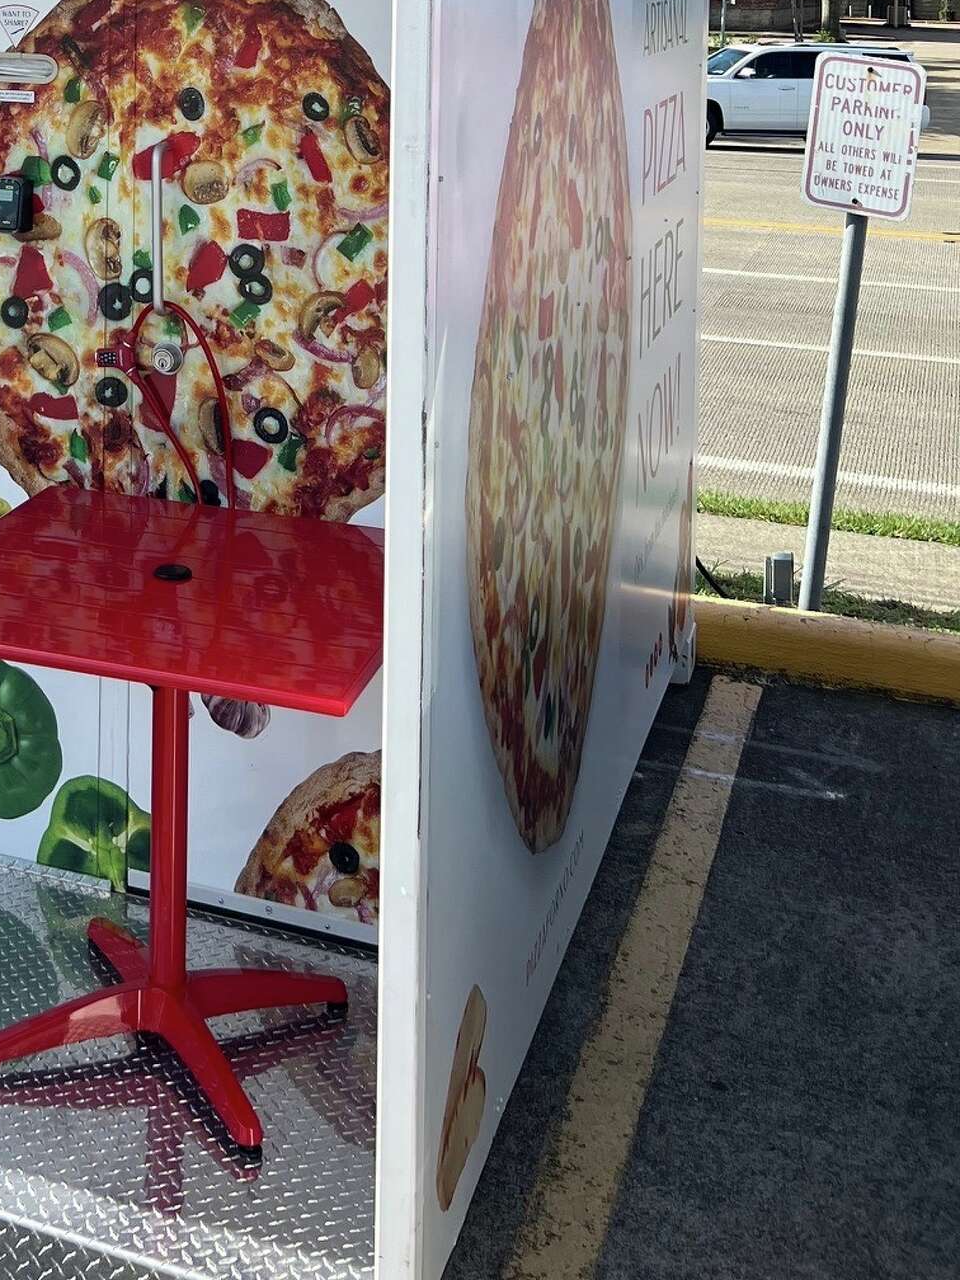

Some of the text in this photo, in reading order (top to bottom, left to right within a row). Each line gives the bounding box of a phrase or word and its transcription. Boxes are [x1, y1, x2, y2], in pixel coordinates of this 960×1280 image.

[825, 73, 913, 96] CUSTOMER
[843, 120, 884, 141] ONLY
[642, 90, 686, 206] PIZZA
[817, 141, 835, 154] ALL
[841, 144, 876, 161] OTHERS
[826, 159, 893, 181] BE TOWED AT
[814, 174, 900, 201] OWNERS EXPENSE
[640, 218, 684, 360] HERE
[636, 352, 682, 508] NOW!
